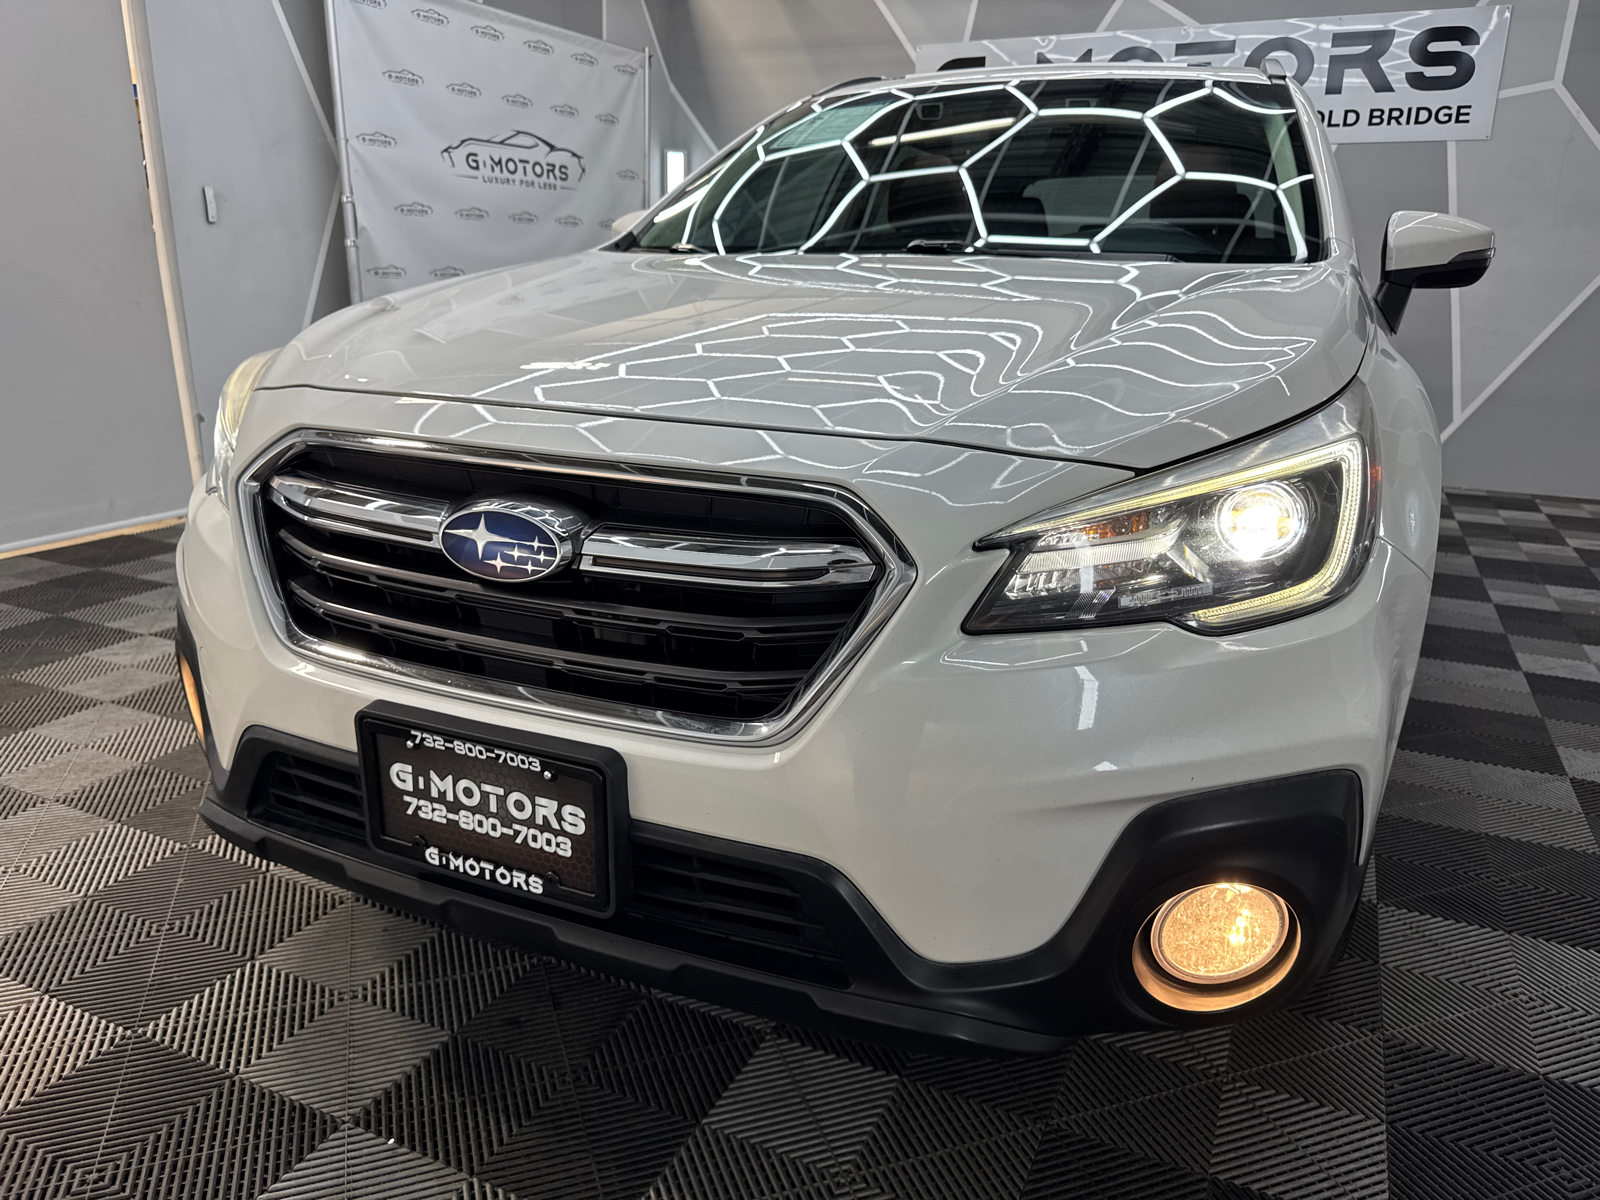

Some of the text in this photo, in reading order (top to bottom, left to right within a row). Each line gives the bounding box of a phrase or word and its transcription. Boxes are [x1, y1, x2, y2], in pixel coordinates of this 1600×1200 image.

[1367, 105, 1472, 127] BRIDGE
[482, 175, 558, 191] LUXURY FOR LESS
[489, 154, 569, 182] MOTORS
[410, 730, 540, 772] 732-800-7003
[429, 769, 587, 836] MOTORS
[403, 795, 573, 859] 732-800-7003
[448, 851, 544, 895] MOTORS
